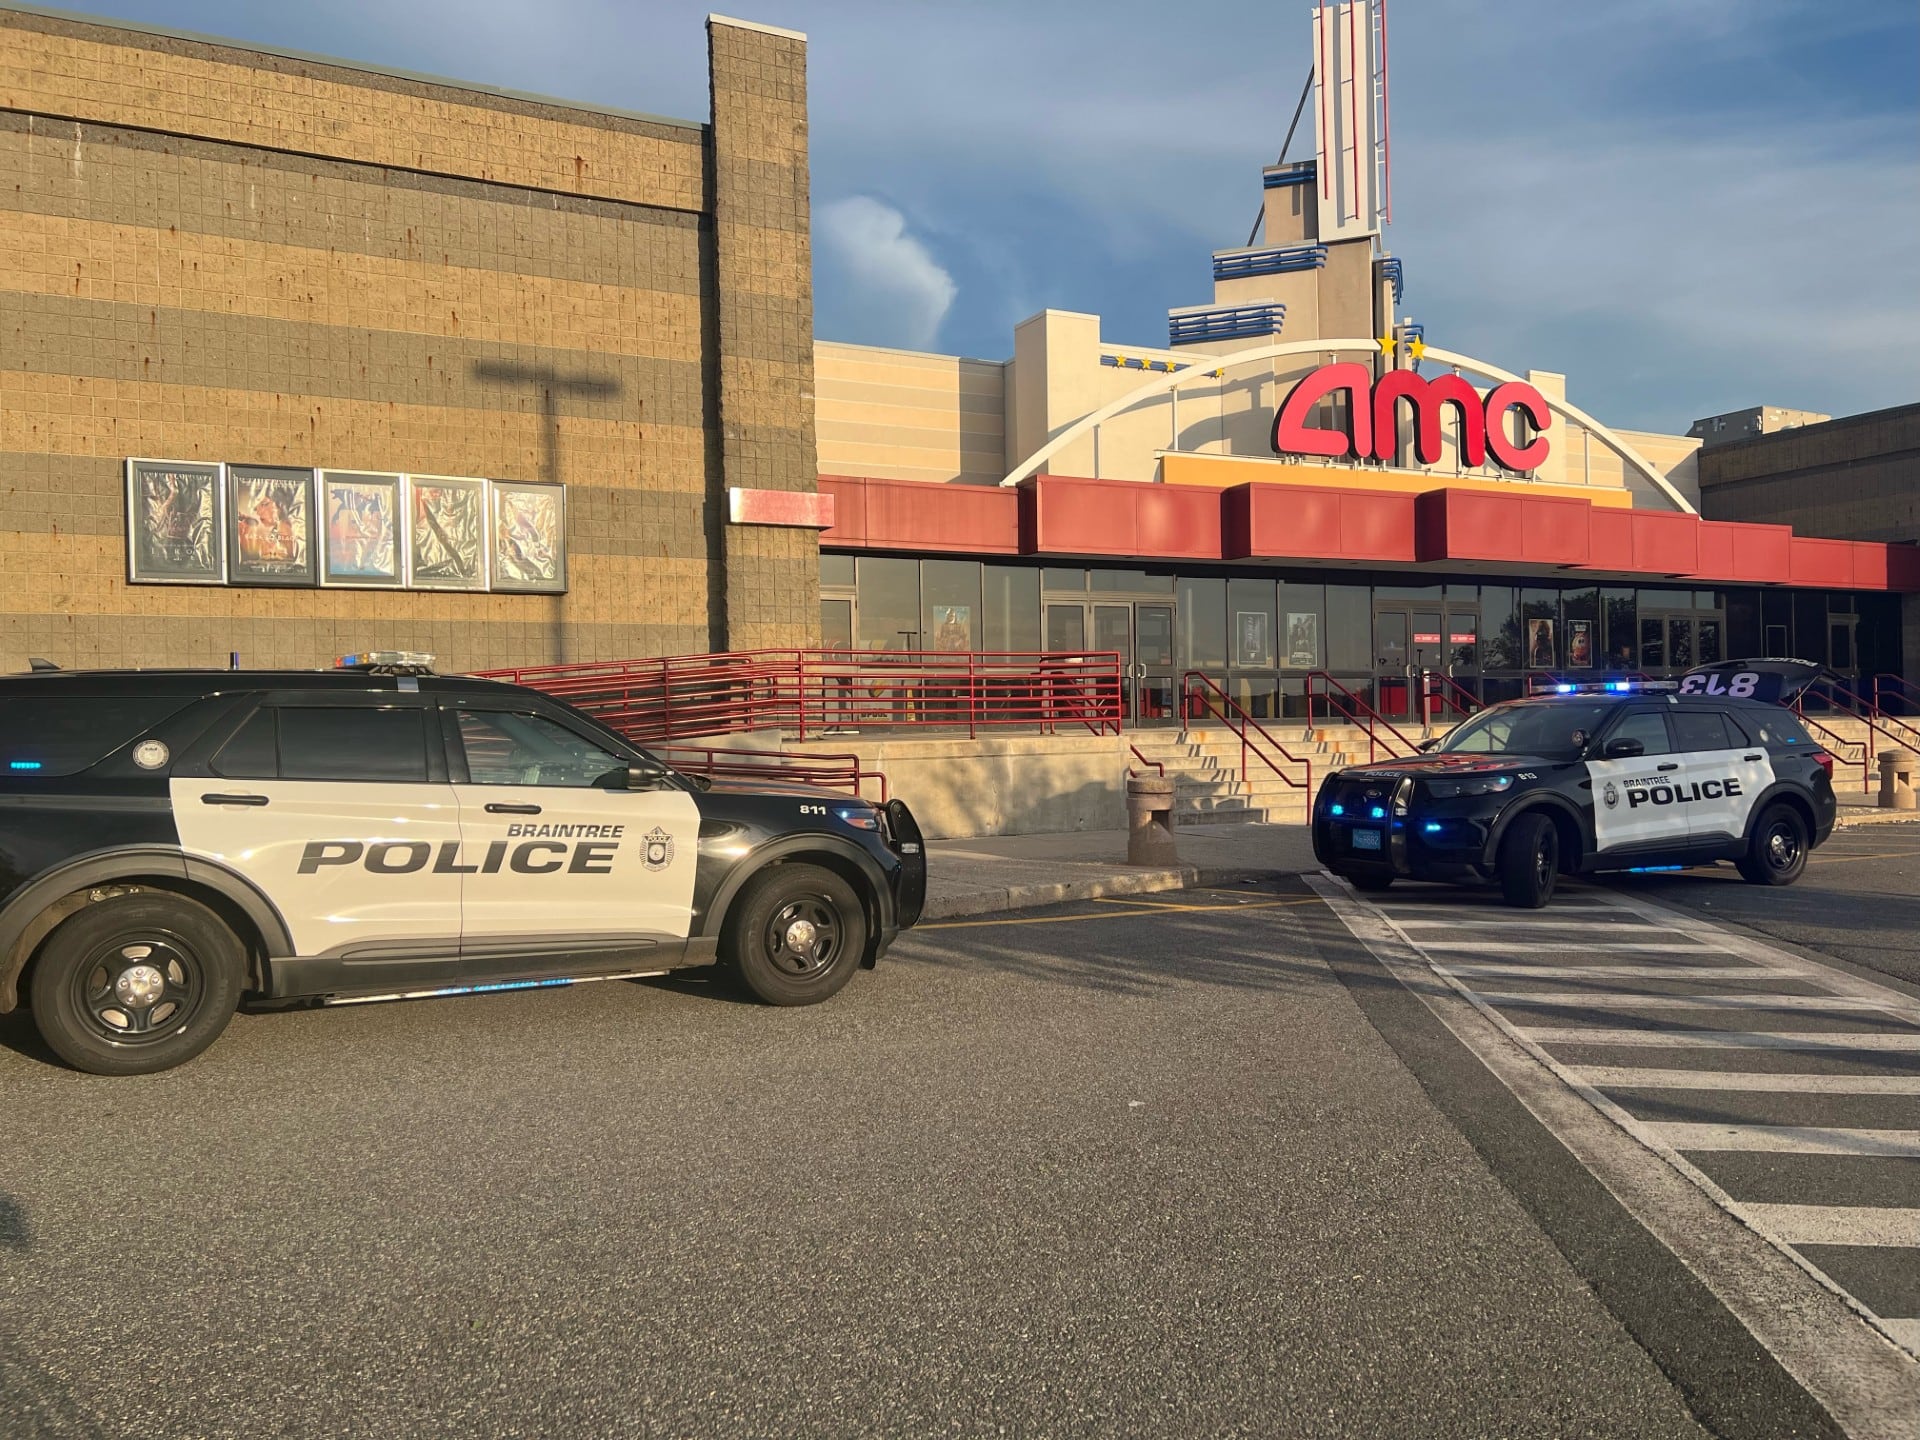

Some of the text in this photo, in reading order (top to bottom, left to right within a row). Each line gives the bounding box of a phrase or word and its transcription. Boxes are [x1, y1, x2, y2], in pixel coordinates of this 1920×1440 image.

[1679, 673, 1759, 697] 813
[1623, 775, 1670, 788] BRAINTREE
[1626, 778, 1743, 808] POLICE
[799, 804, 826, 816] 811
[507, 824, 625, 838] BRAINTREE
[296, 841, 620, 874] POLICE
